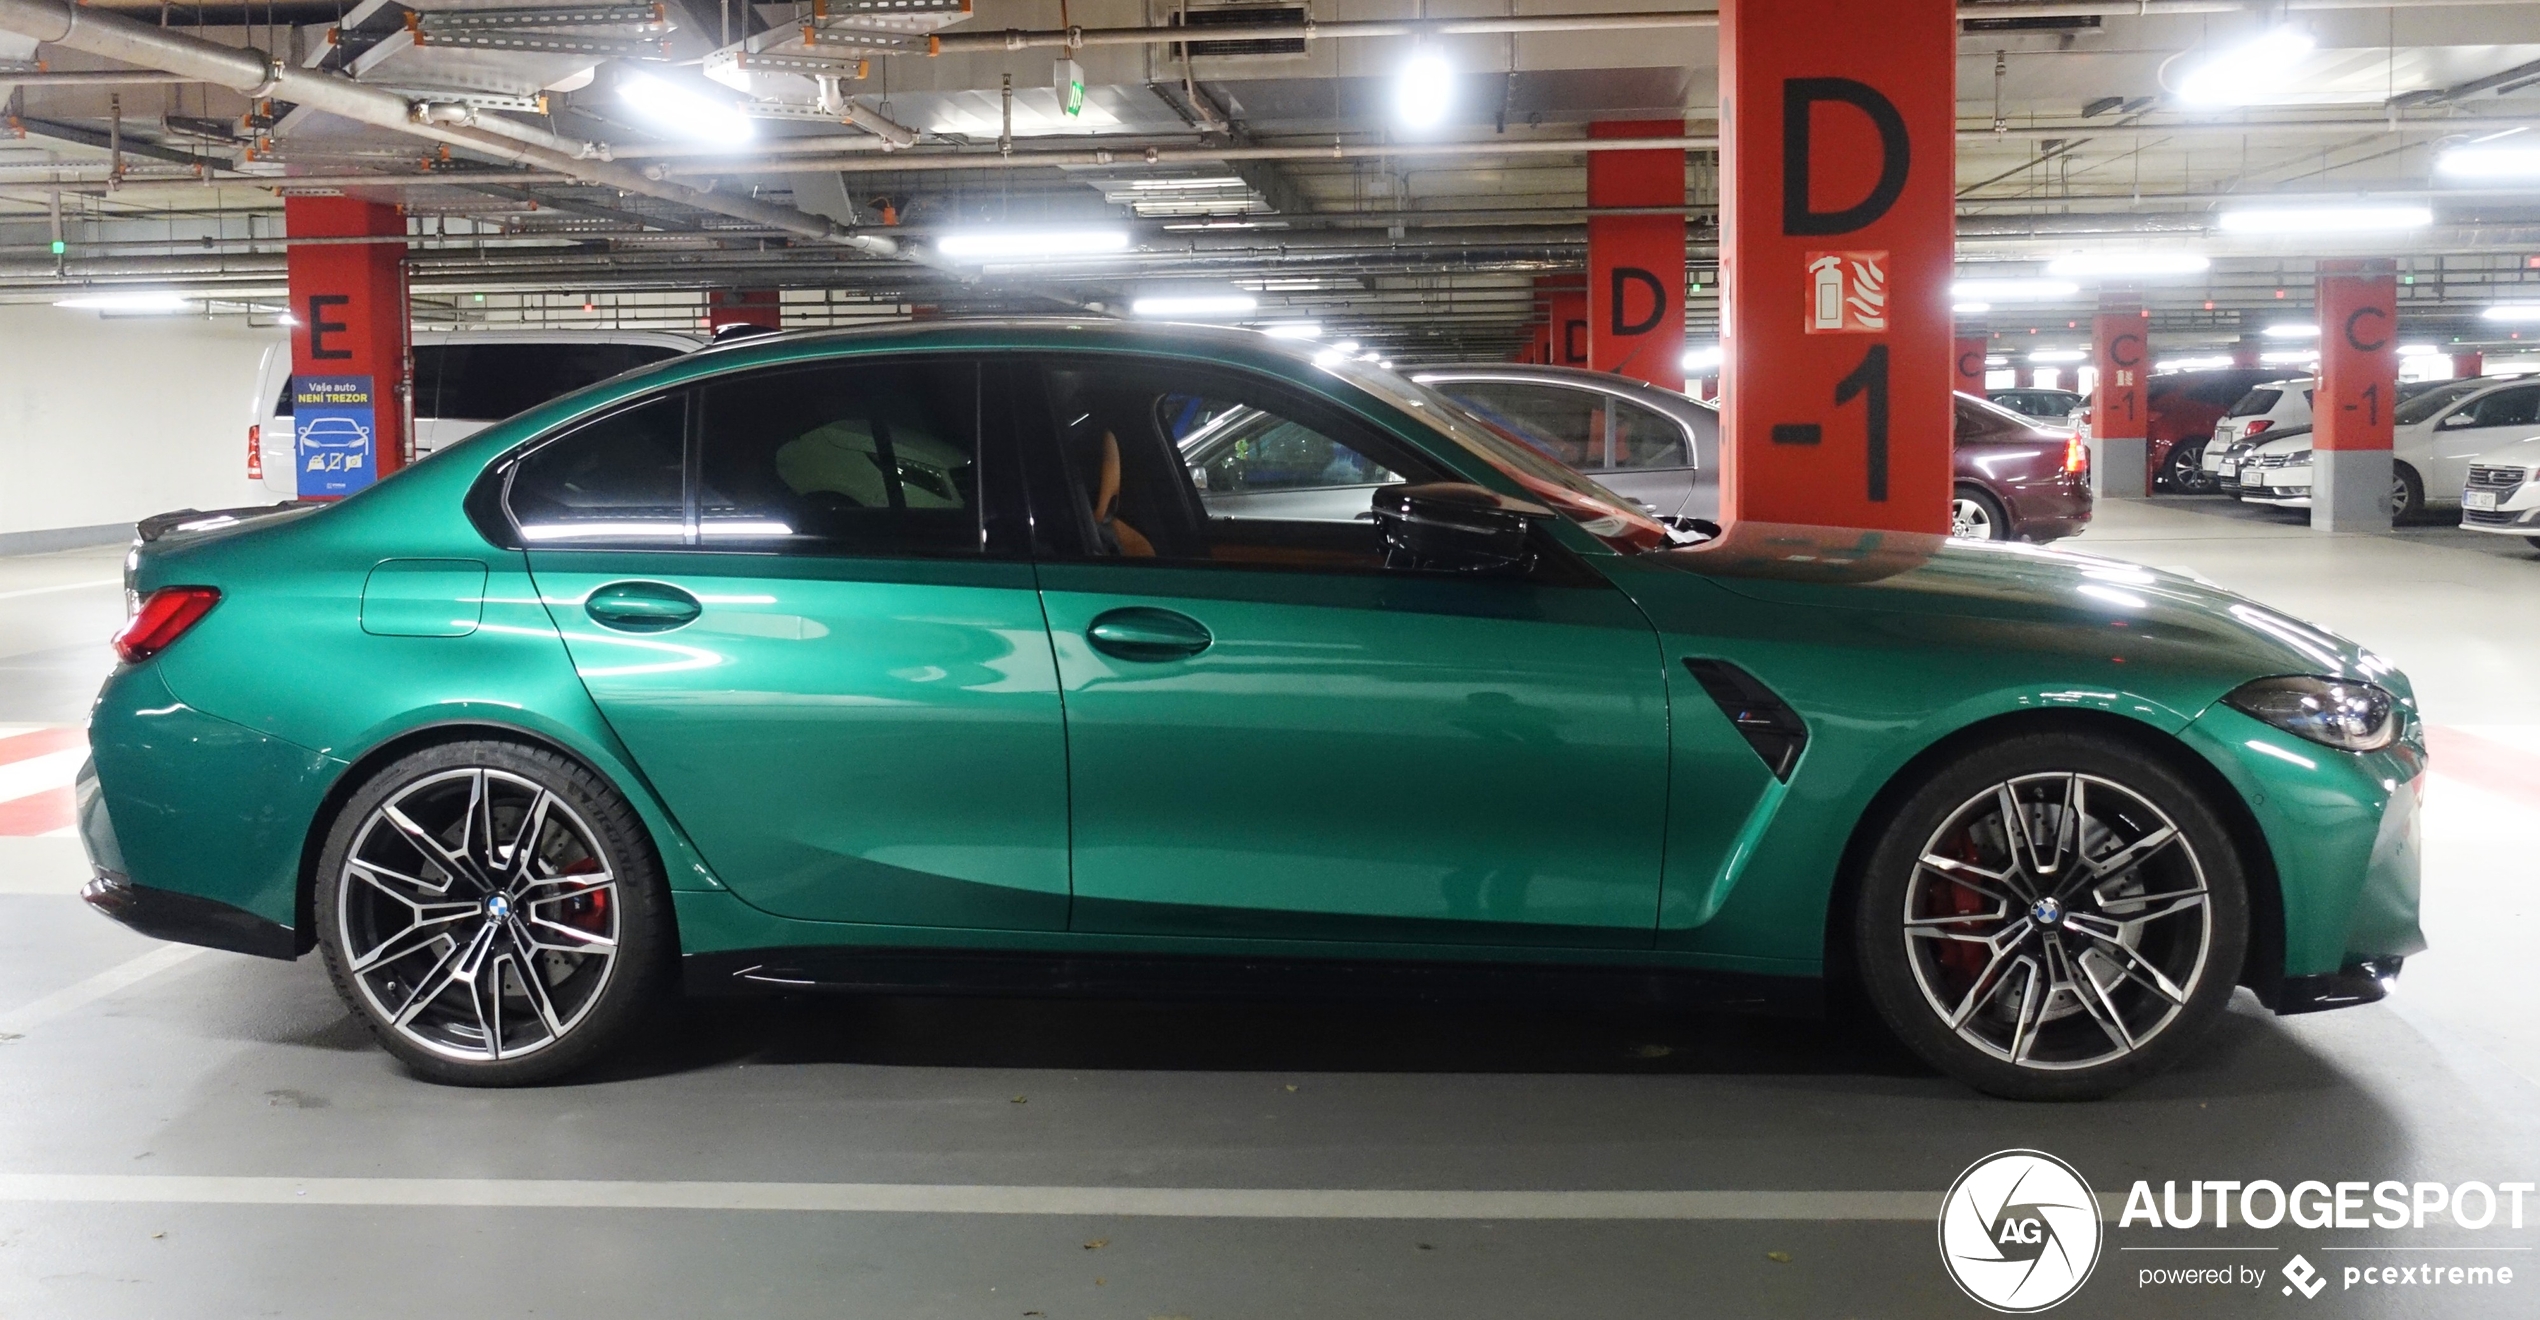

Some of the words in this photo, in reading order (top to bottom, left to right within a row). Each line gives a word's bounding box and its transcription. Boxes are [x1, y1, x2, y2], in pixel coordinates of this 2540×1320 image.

[1783, 77, 1911, 237] D
[1611, 267, 1667, 336] D
[309, 295, 353, 360] E
[2345, 307, 2386, 352] C
[1959, 352, 1981, 378] C
[2110, 334, 2140, 366] C
[298, 391, 324, 403] NENÍ
[325, 393, 368, 403] TREZOR
[309, 382, 332, 392] Vaše
[334, 383, 356, 392] auto
[2110, 390, 2134, 421] -1
[2343, 384, 2378, 426] -1
[1771, 344, 1889, 502] -1
